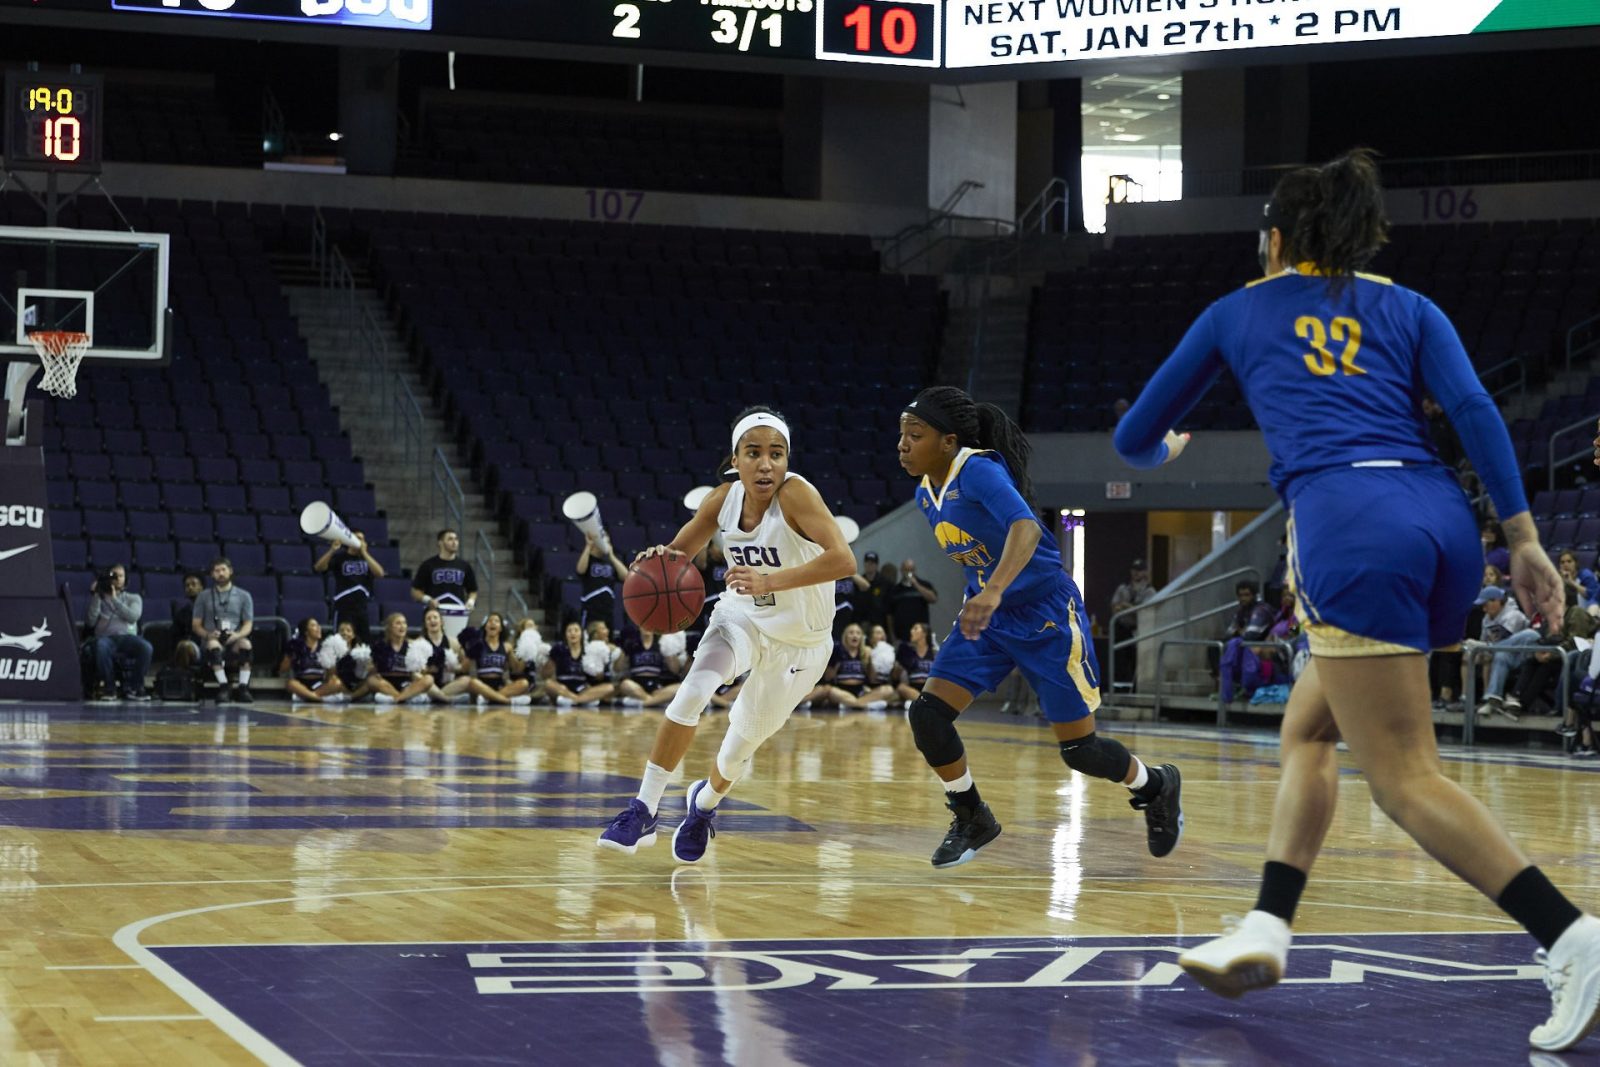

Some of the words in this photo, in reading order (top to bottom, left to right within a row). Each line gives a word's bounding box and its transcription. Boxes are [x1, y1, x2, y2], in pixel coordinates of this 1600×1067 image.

[612, 3, 641, 39] 2
[711, 9, 782, 52] 3/1
[844, 4, 917, 55] 10
[964, 0, 1046, 26] NEXT
[1057, 0, 1219, 19] WOMEN
[990, 30, 1068, 58] SAT,
[1079, 24, 1149, 52] JAN
[1163, 17, 1254, 46] 27th
[1295, 12, 1319, 37] 2
[1334, 7, 1401, 35] PM
[44, 116, 81, 161] 10
[584, 189, 645, 222] 107
[1418, 187, 1478, 221] 106
[1294, 315, 1368, 377] 32
[729, 545, 782, 568] GCU
